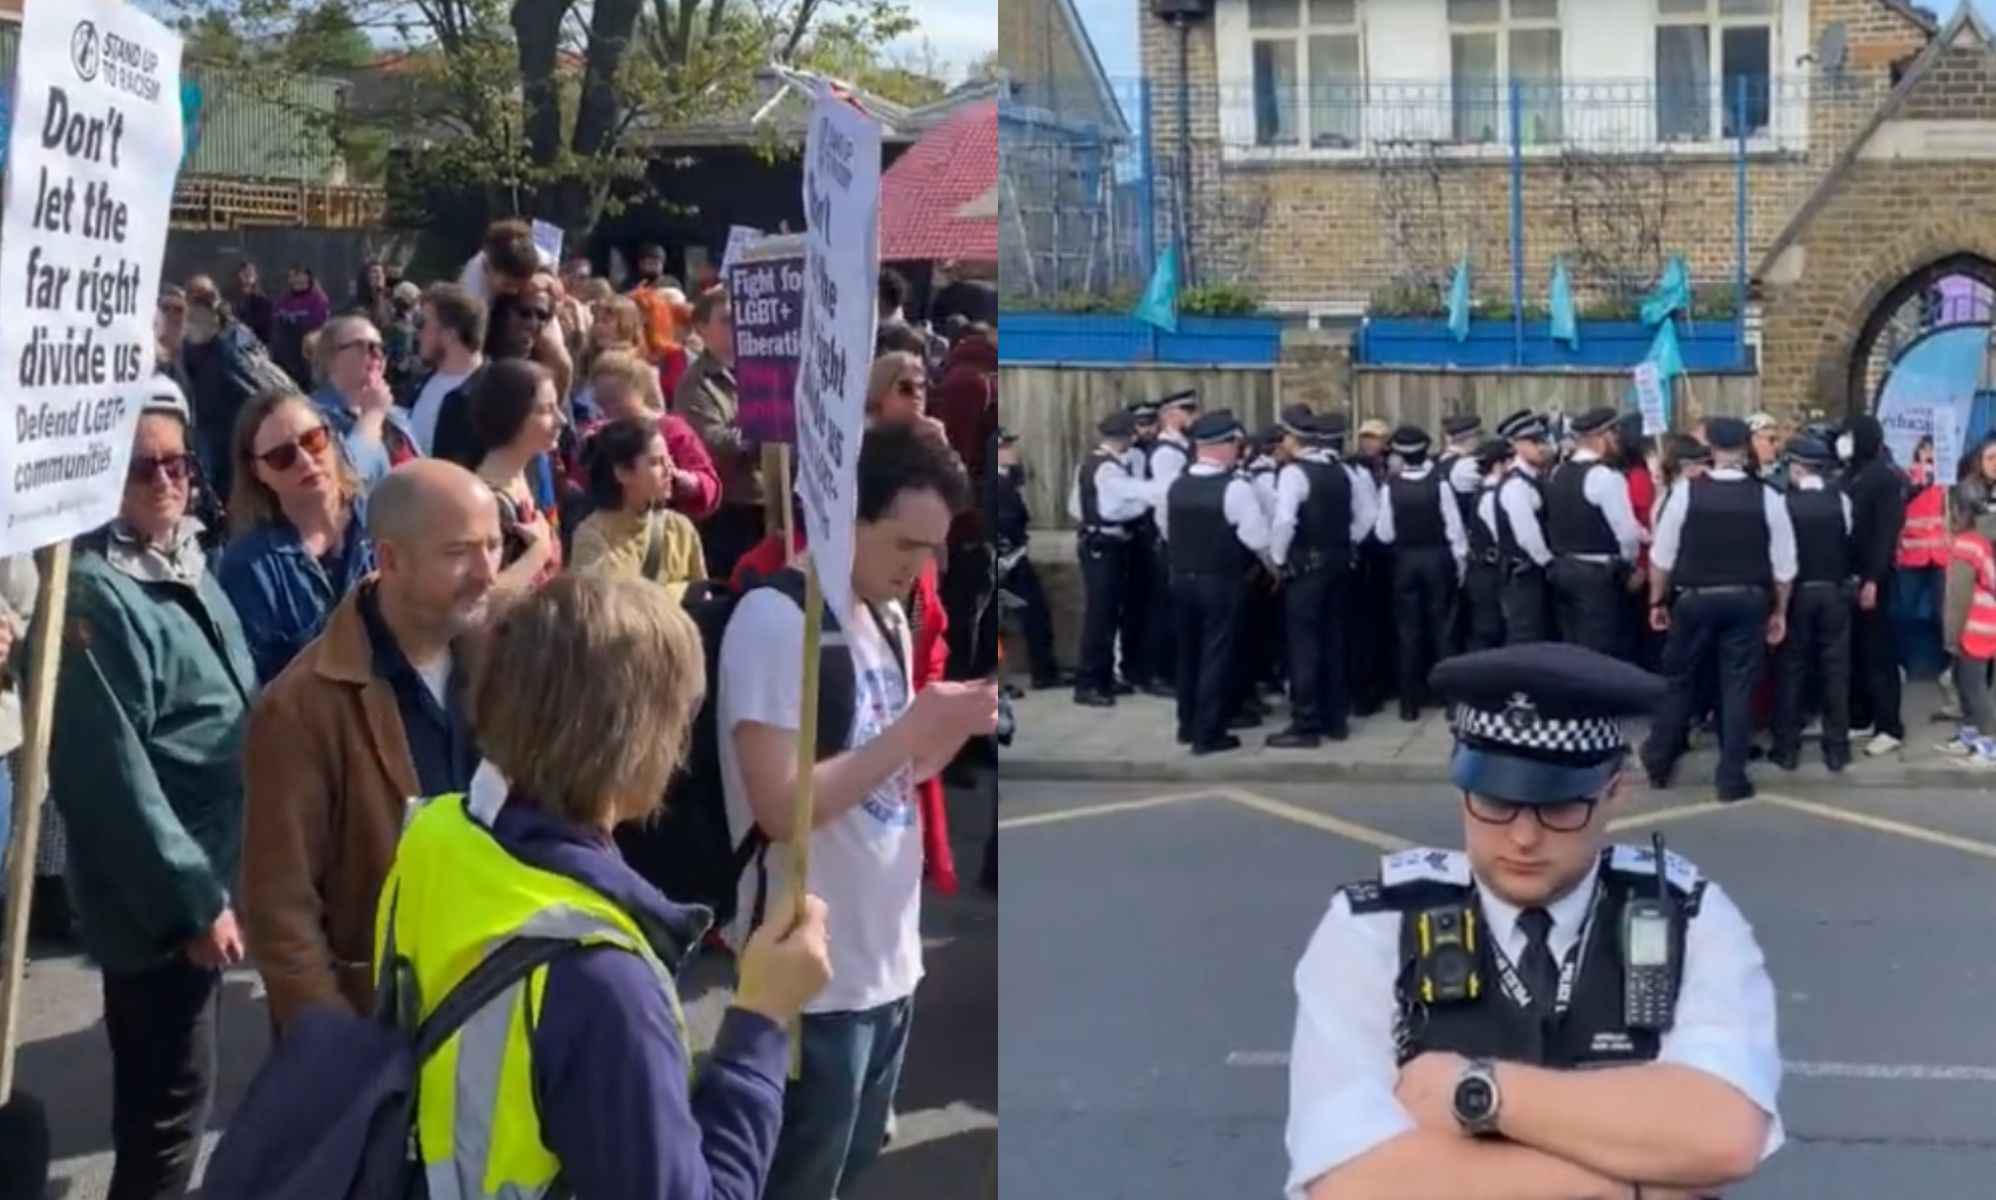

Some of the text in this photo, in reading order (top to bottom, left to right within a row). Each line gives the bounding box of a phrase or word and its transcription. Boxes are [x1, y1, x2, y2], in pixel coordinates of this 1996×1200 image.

[103, 32, 159, 74] STAND UP
[102, 60, 161, 104] TO RACISM
[42, 86, 124, 169] Don't
[32, 166, 128, 244] let the
[26, 245, 140, 328] far right
[733, 264, 802, 298] Fight fo
[735, 299, 793, 326] LGBT+
[19, 325, 142, 387] divide us
[737, 328, 800, 357] liberati
[16, 399, 82, 443] Defend
[15, 440, 112, 493] communities
